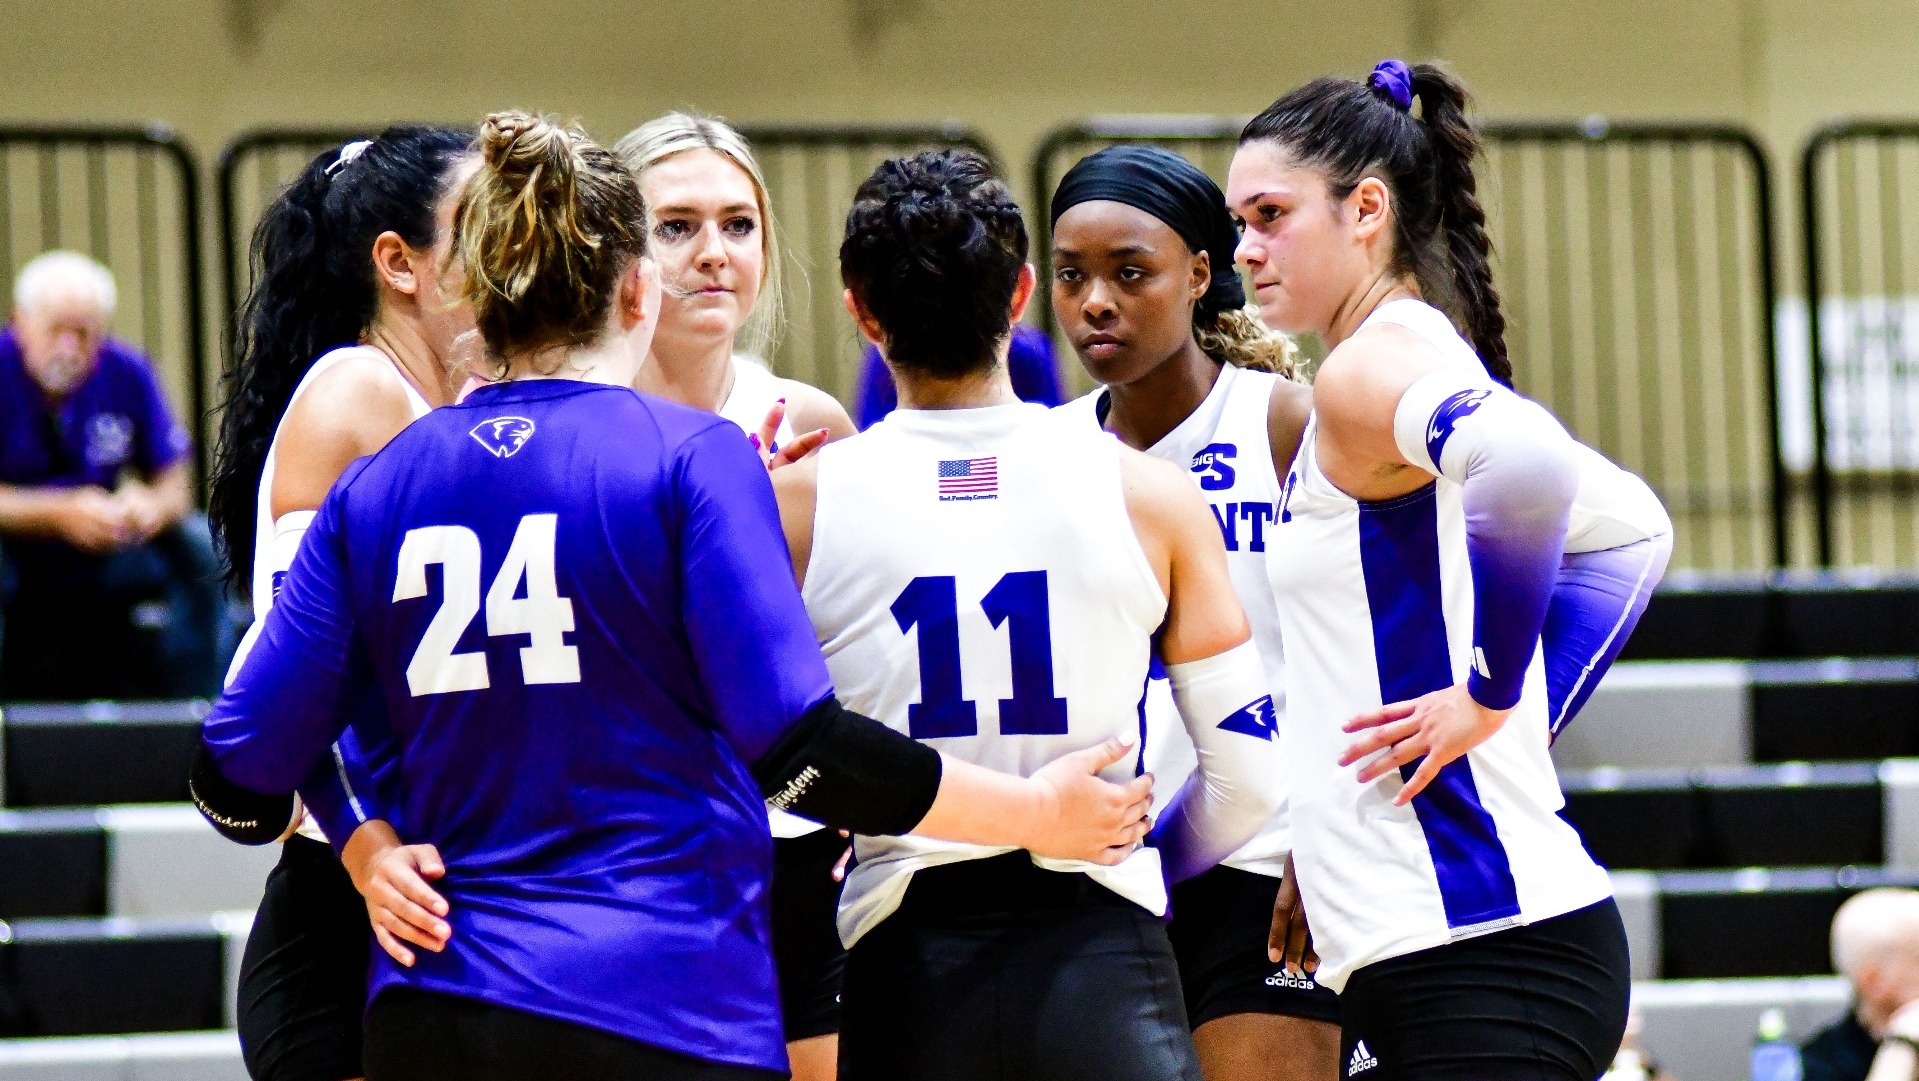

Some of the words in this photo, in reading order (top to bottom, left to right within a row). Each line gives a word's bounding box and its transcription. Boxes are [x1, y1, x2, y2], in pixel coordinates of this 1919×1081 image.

[392, 513, 581, 697] 24
[890, 570, 1068, 739] 11
[1265, 977, 1315, 990] adidas
[1348, 1057, 1378, 1077] adidas
